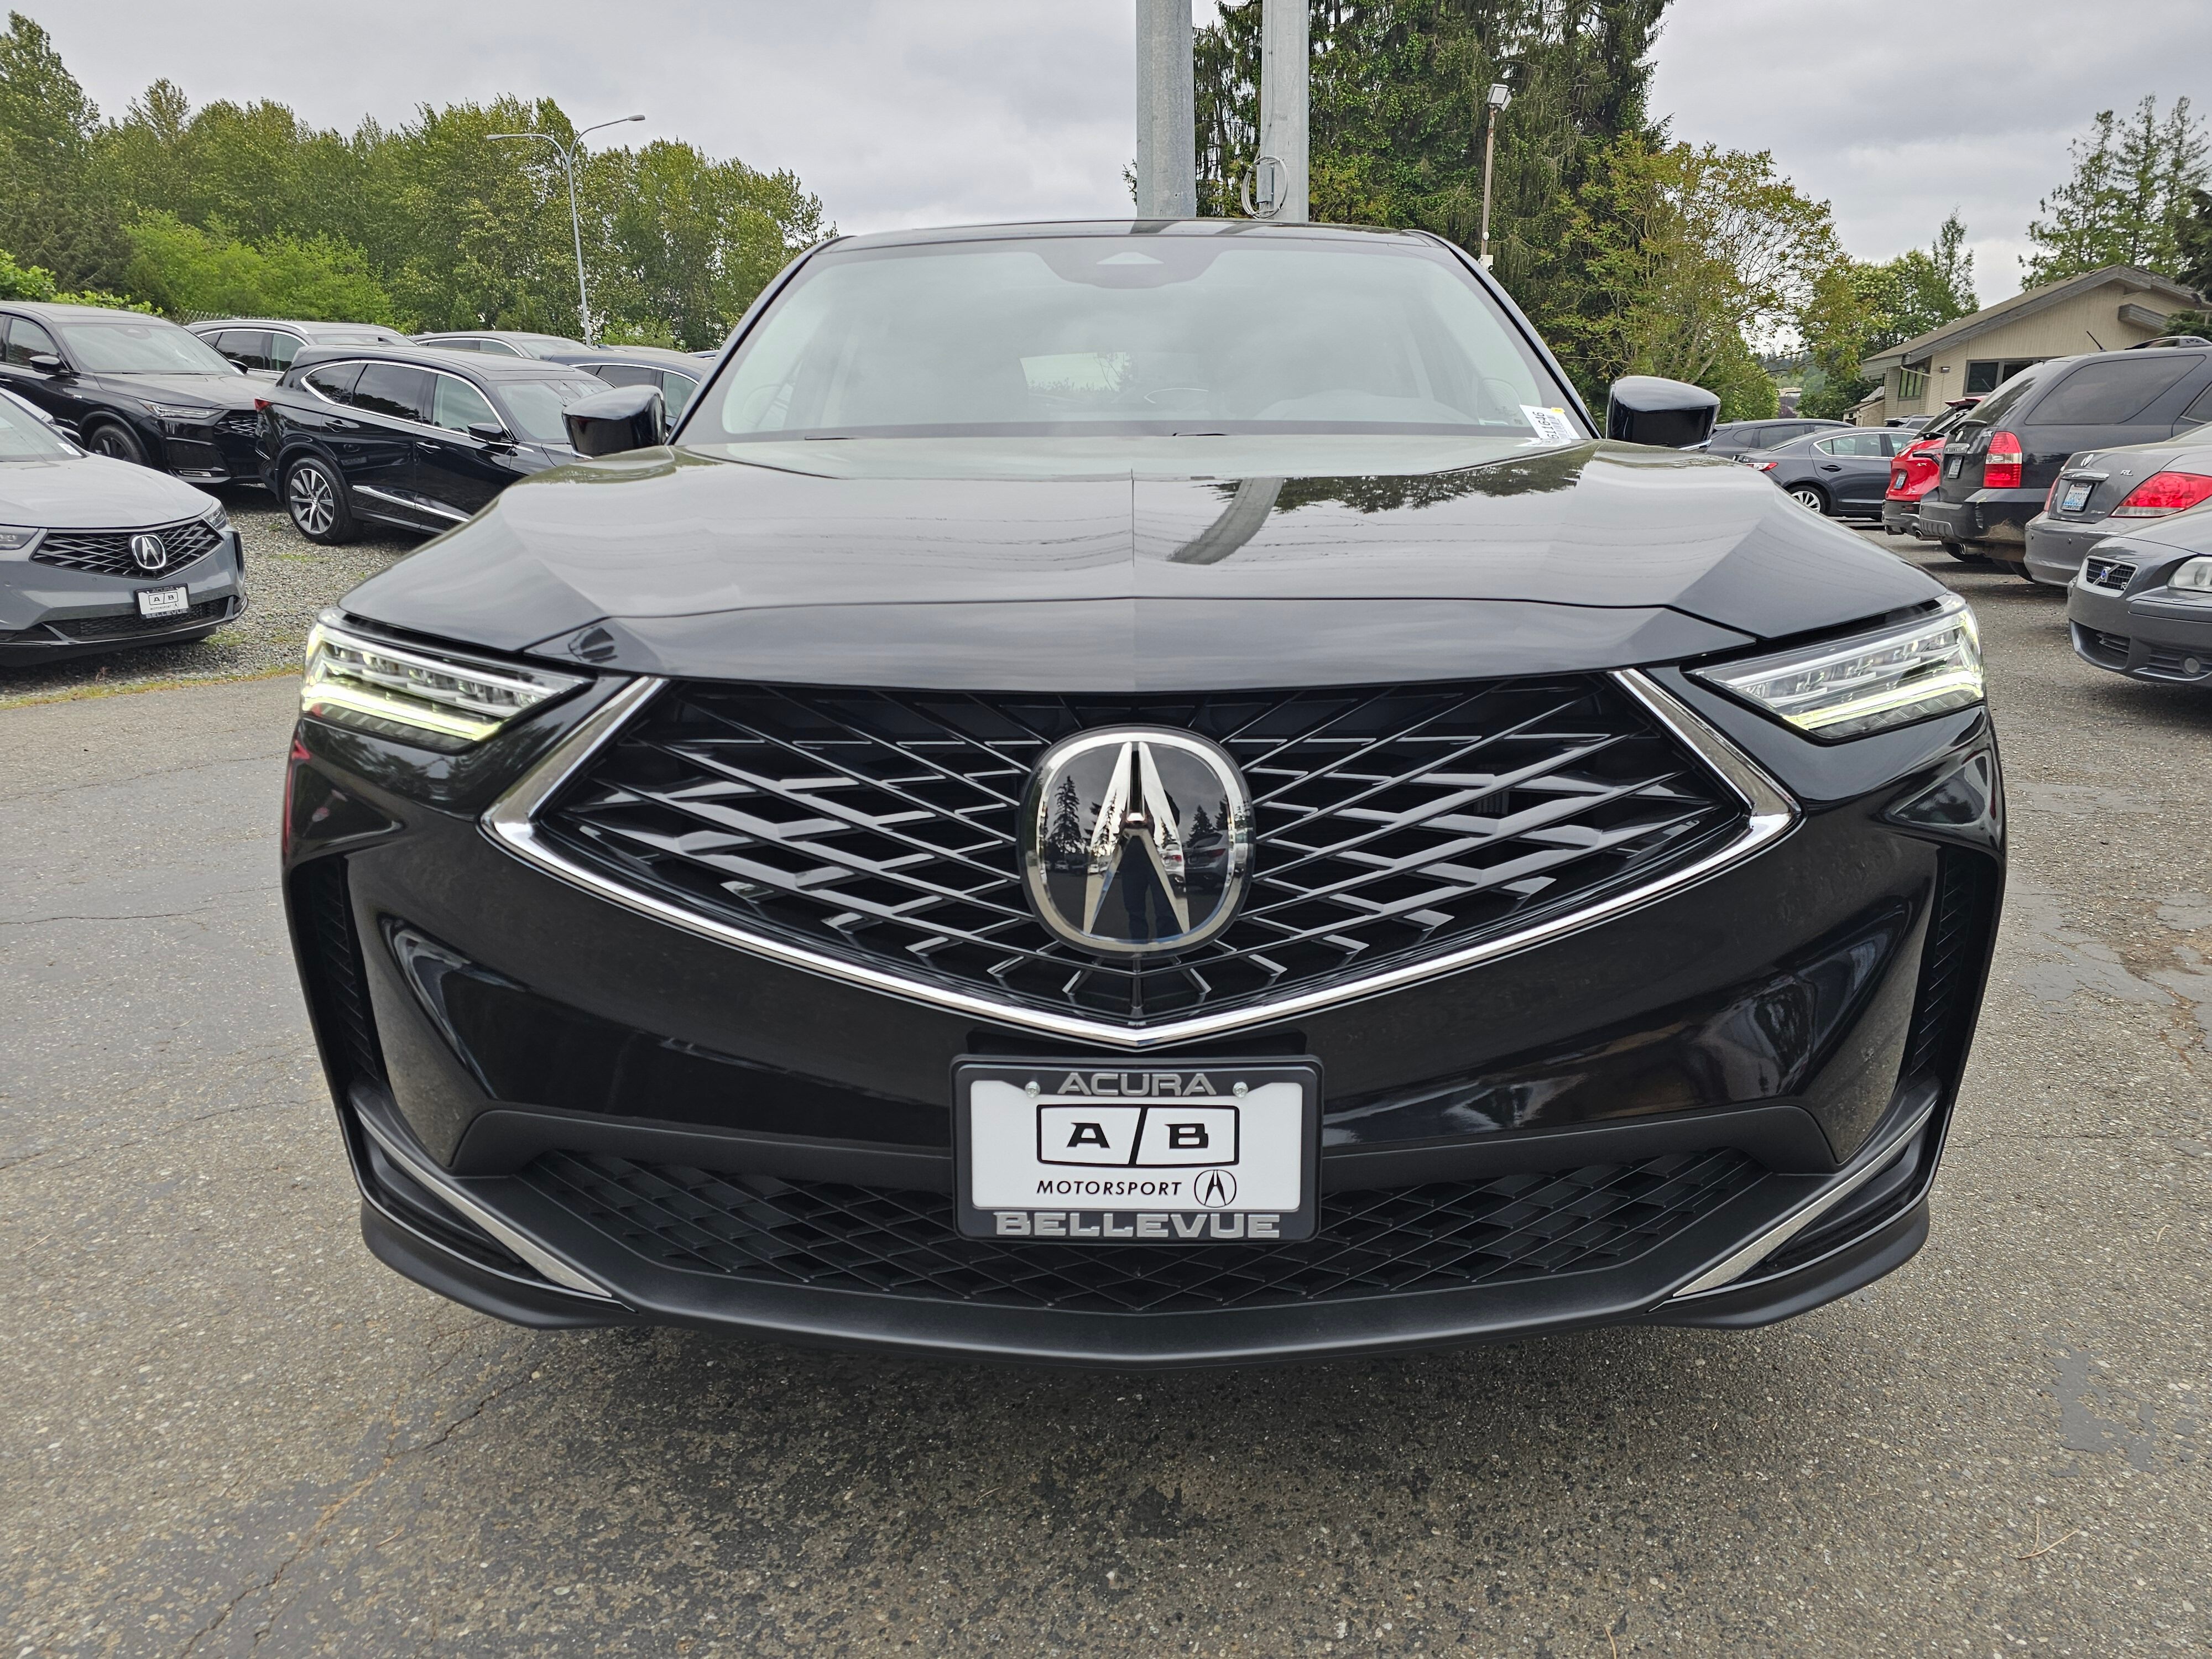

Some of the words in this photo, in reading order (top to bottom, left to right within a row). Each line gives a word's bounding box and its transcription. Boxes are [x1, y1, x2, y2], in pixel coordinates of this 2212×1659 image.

[145, 609, 188, 619] BELLEVUE
[1057, 1072, 1217, 1097] ACURA
[1066, 1122, 1110, 1149] A
[1164, 1123, 1209, 1149] B
[1036, 1180, 1182, 1196] MOTORSPORT
[993, 1212, 1280, 1239] BELLEVUE
